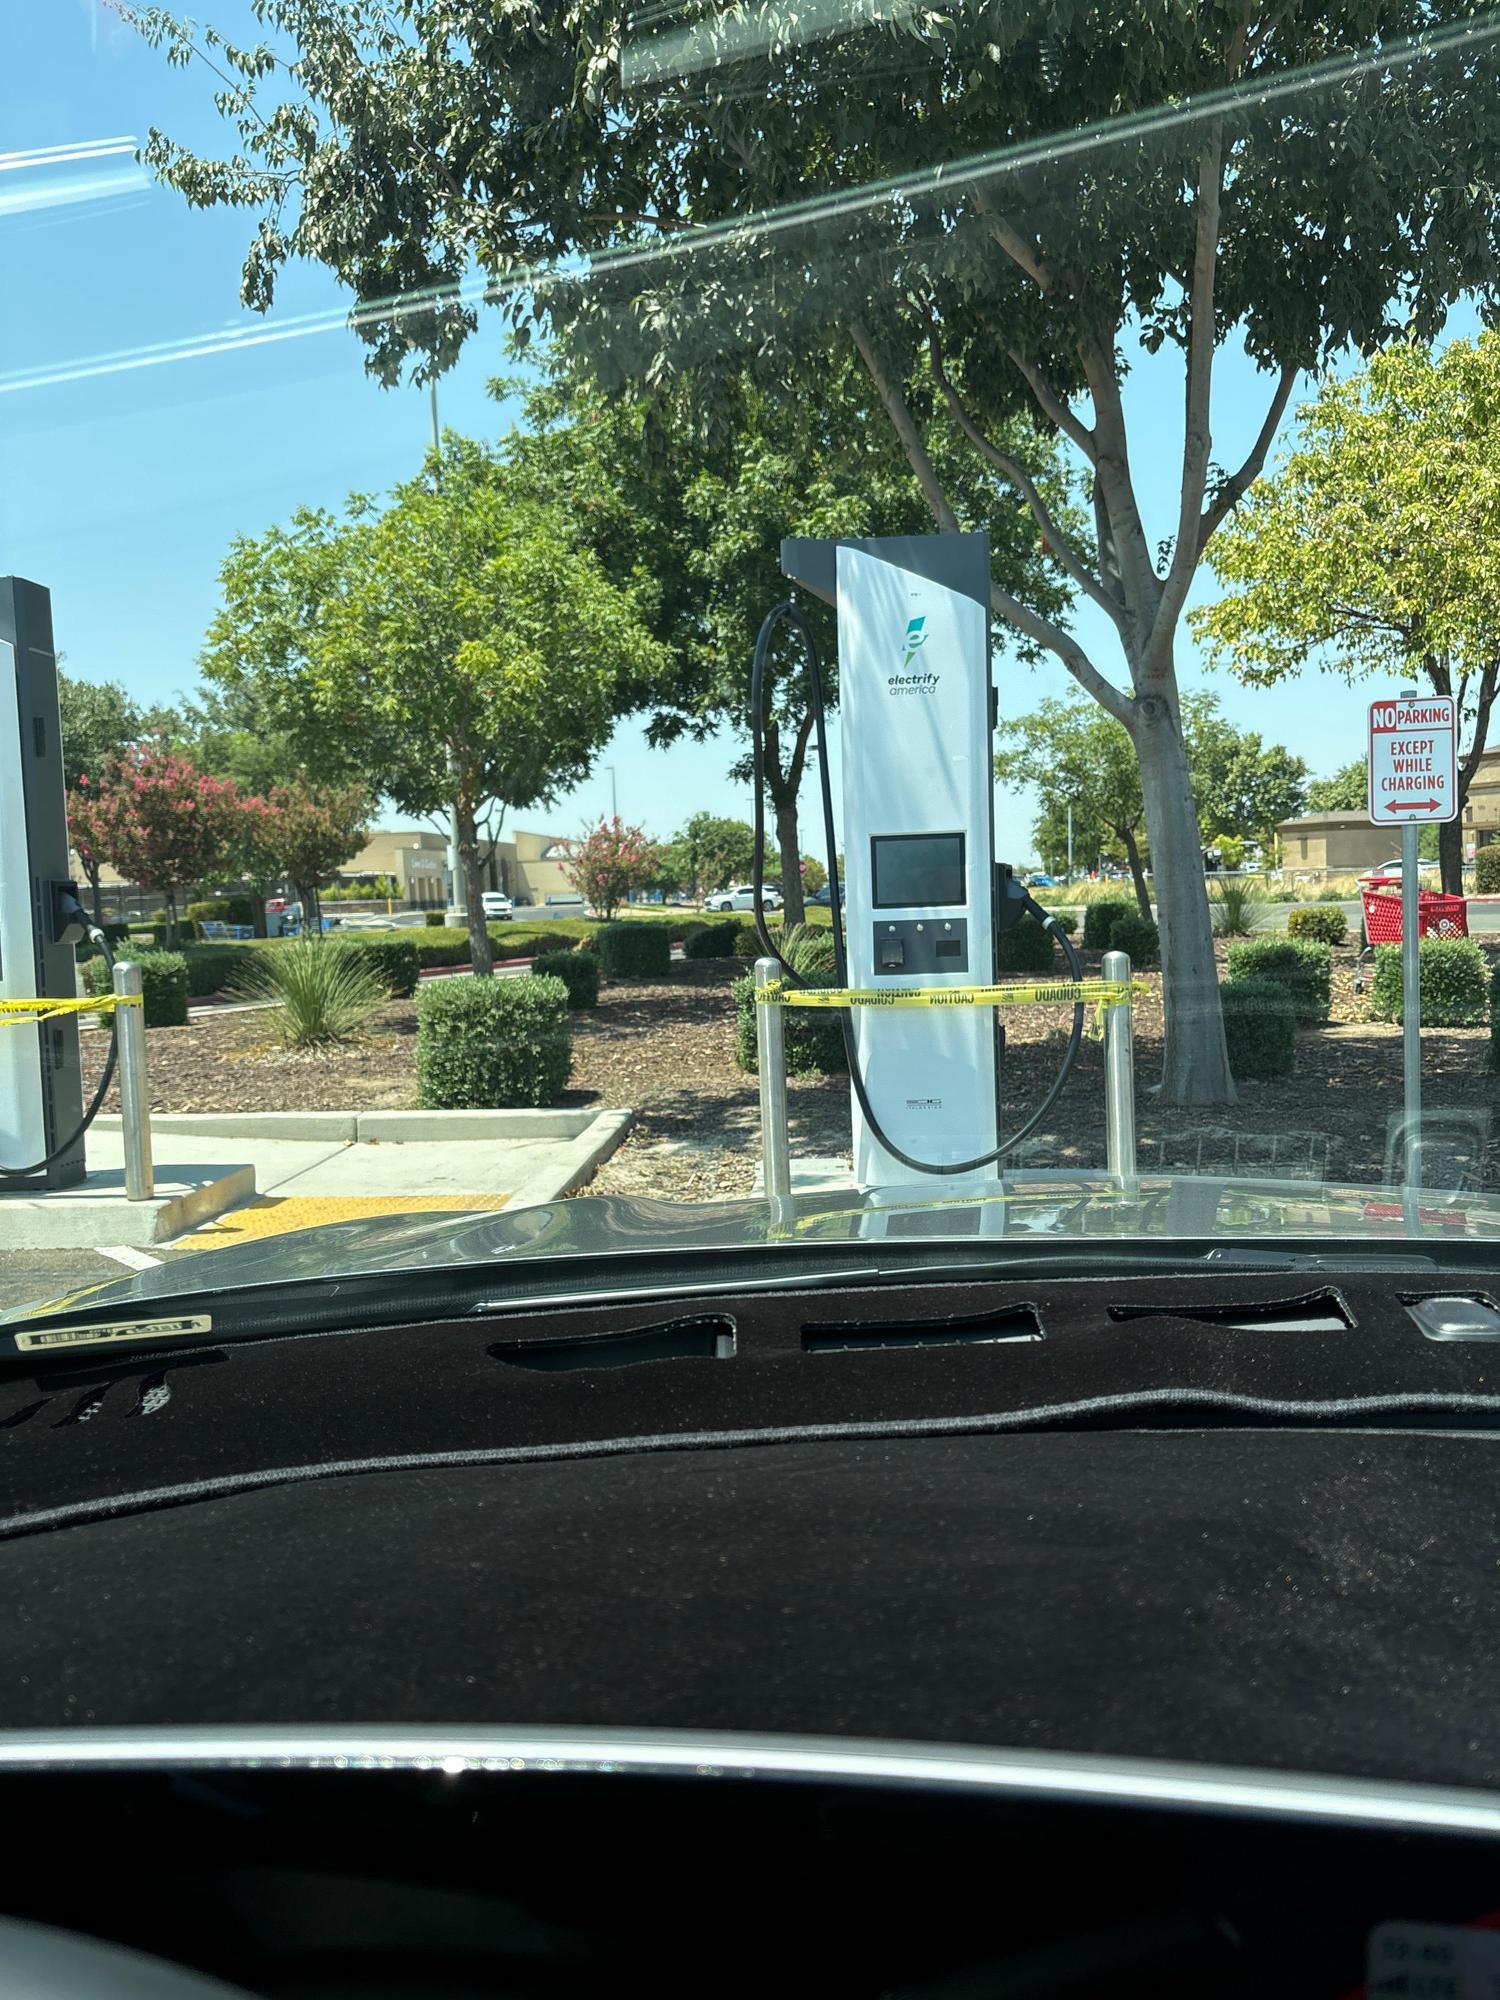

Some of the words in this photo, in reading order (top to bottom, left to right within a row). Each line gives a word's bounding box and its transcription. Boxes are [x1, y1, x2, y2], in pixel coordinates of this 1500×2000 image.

[888, 673, 940, 685] electrify
[889, 685, 936, 696] america
[1372, 707, 1397, 729] NO
[1397, 707, 1450, 725] PARKING
[1390, 740, 1434, 756] EXCEPT
[1393, 758, 1432, 773] WHILE
[1381, 775, 1444, 791] CHARGING
